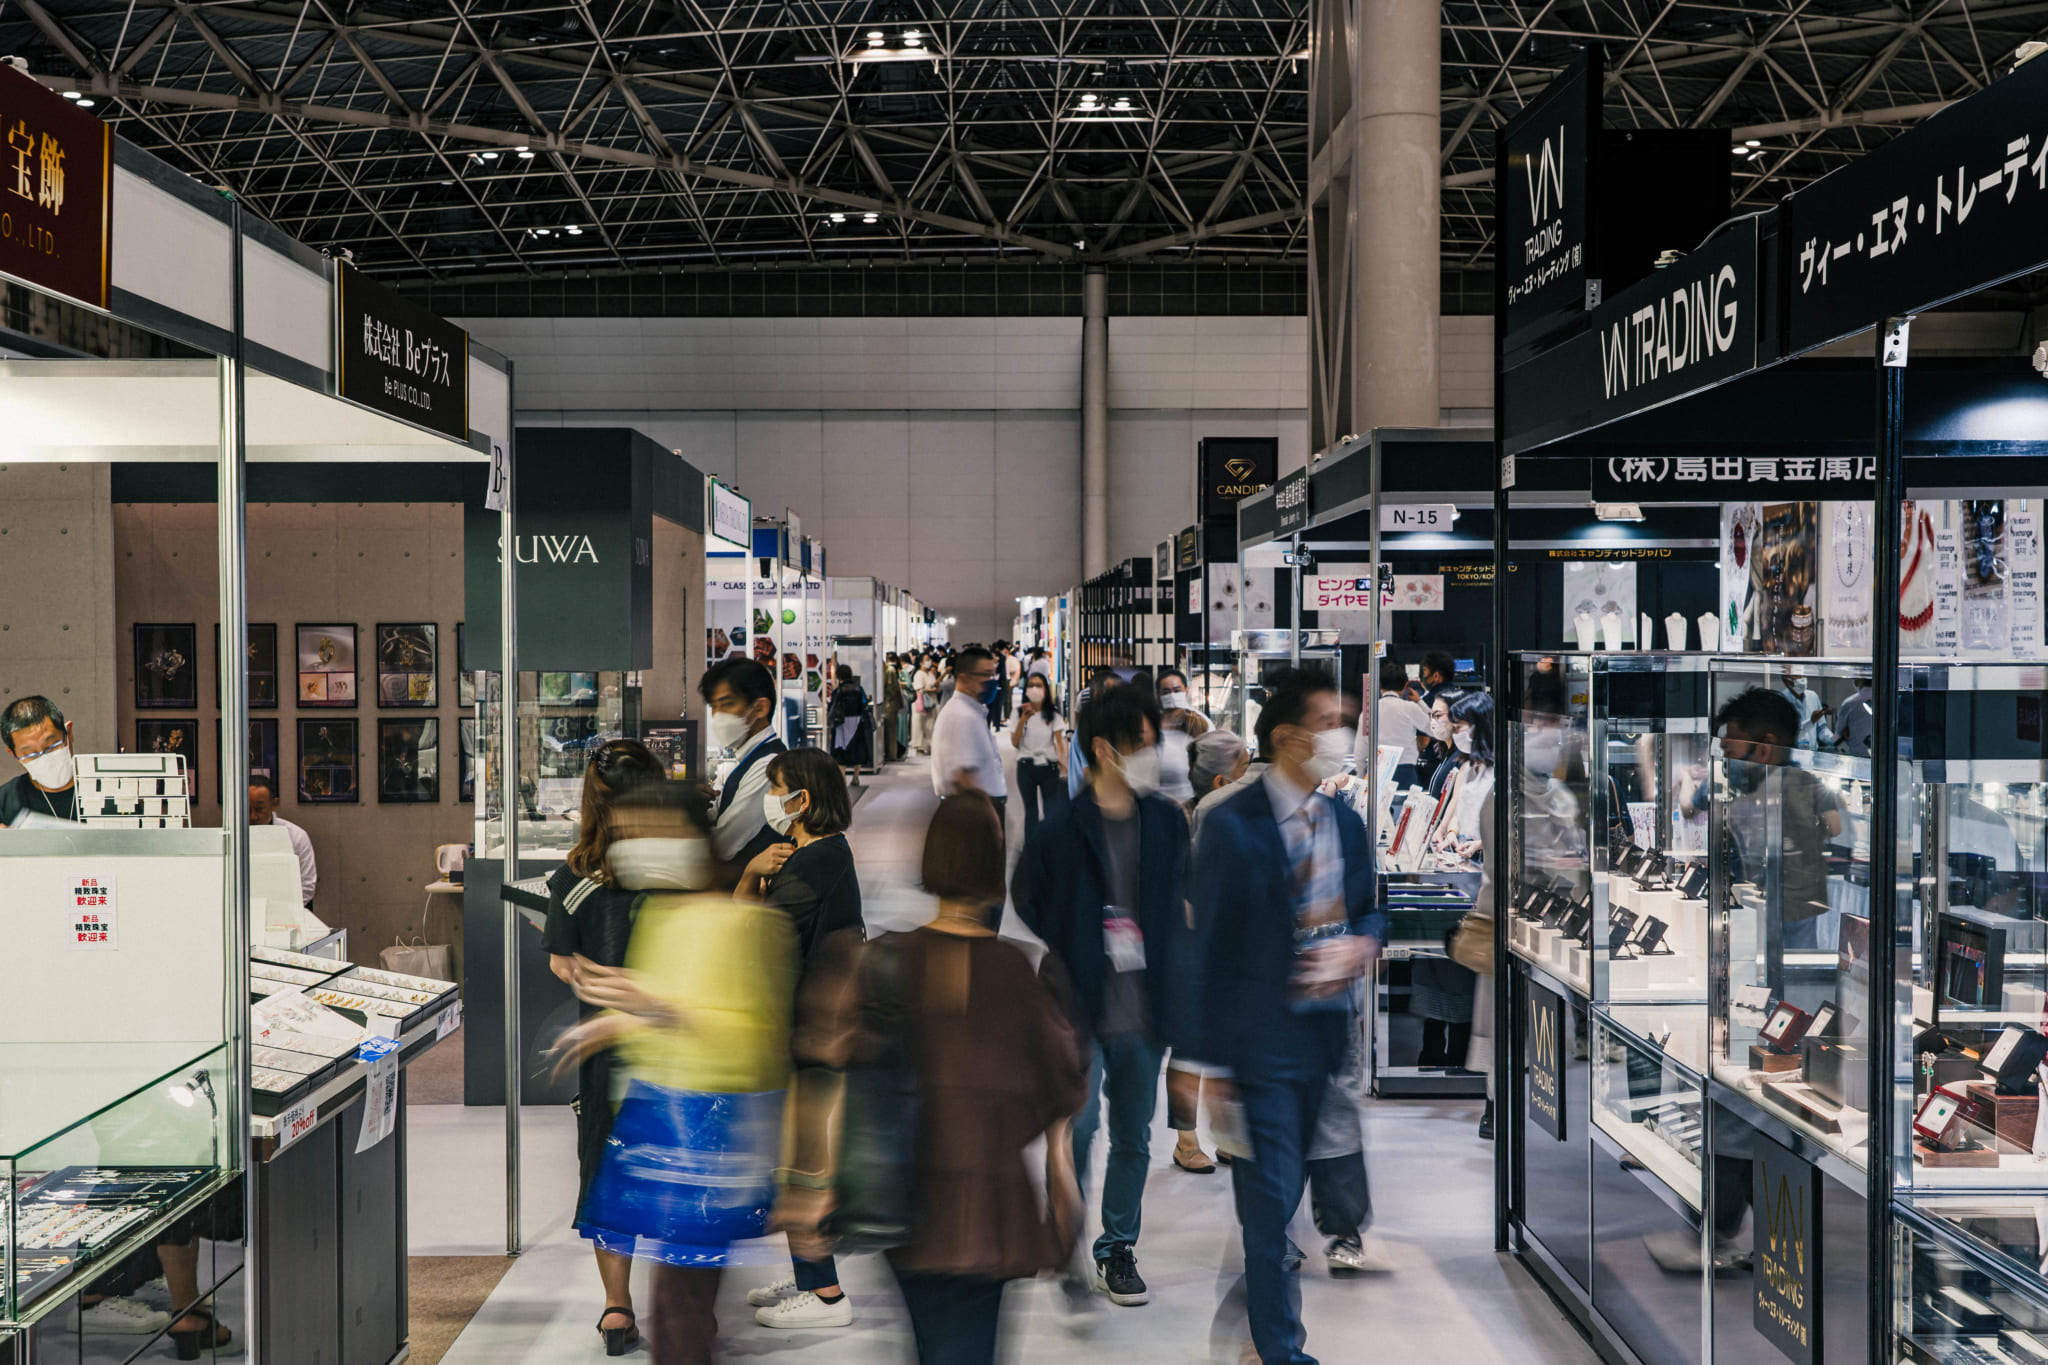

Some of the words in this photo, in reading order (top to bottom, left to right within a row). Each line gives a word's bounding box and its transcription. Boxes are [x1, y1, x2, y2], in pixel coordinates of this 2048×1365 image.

[8, 119, 66, 216] 宝飾
[1525, 218, 1563, 266] TRADING
[1632, 264, 1738, 387] TRADING
[363, 312, 401, 367] 株式会社
[405, 329, 450, 388] Beプラス
[393, 379, 407, 401] PLUS
[1393, 510, 1438, 524] N-15
[1318, 594, 1395, 606] ダイヤモド
[1533, 1064, 1555, 1097] TRADING
[291, 1108, 315, 1138] 20%off
[1762, 1253, 1804, 1309] TRADING
